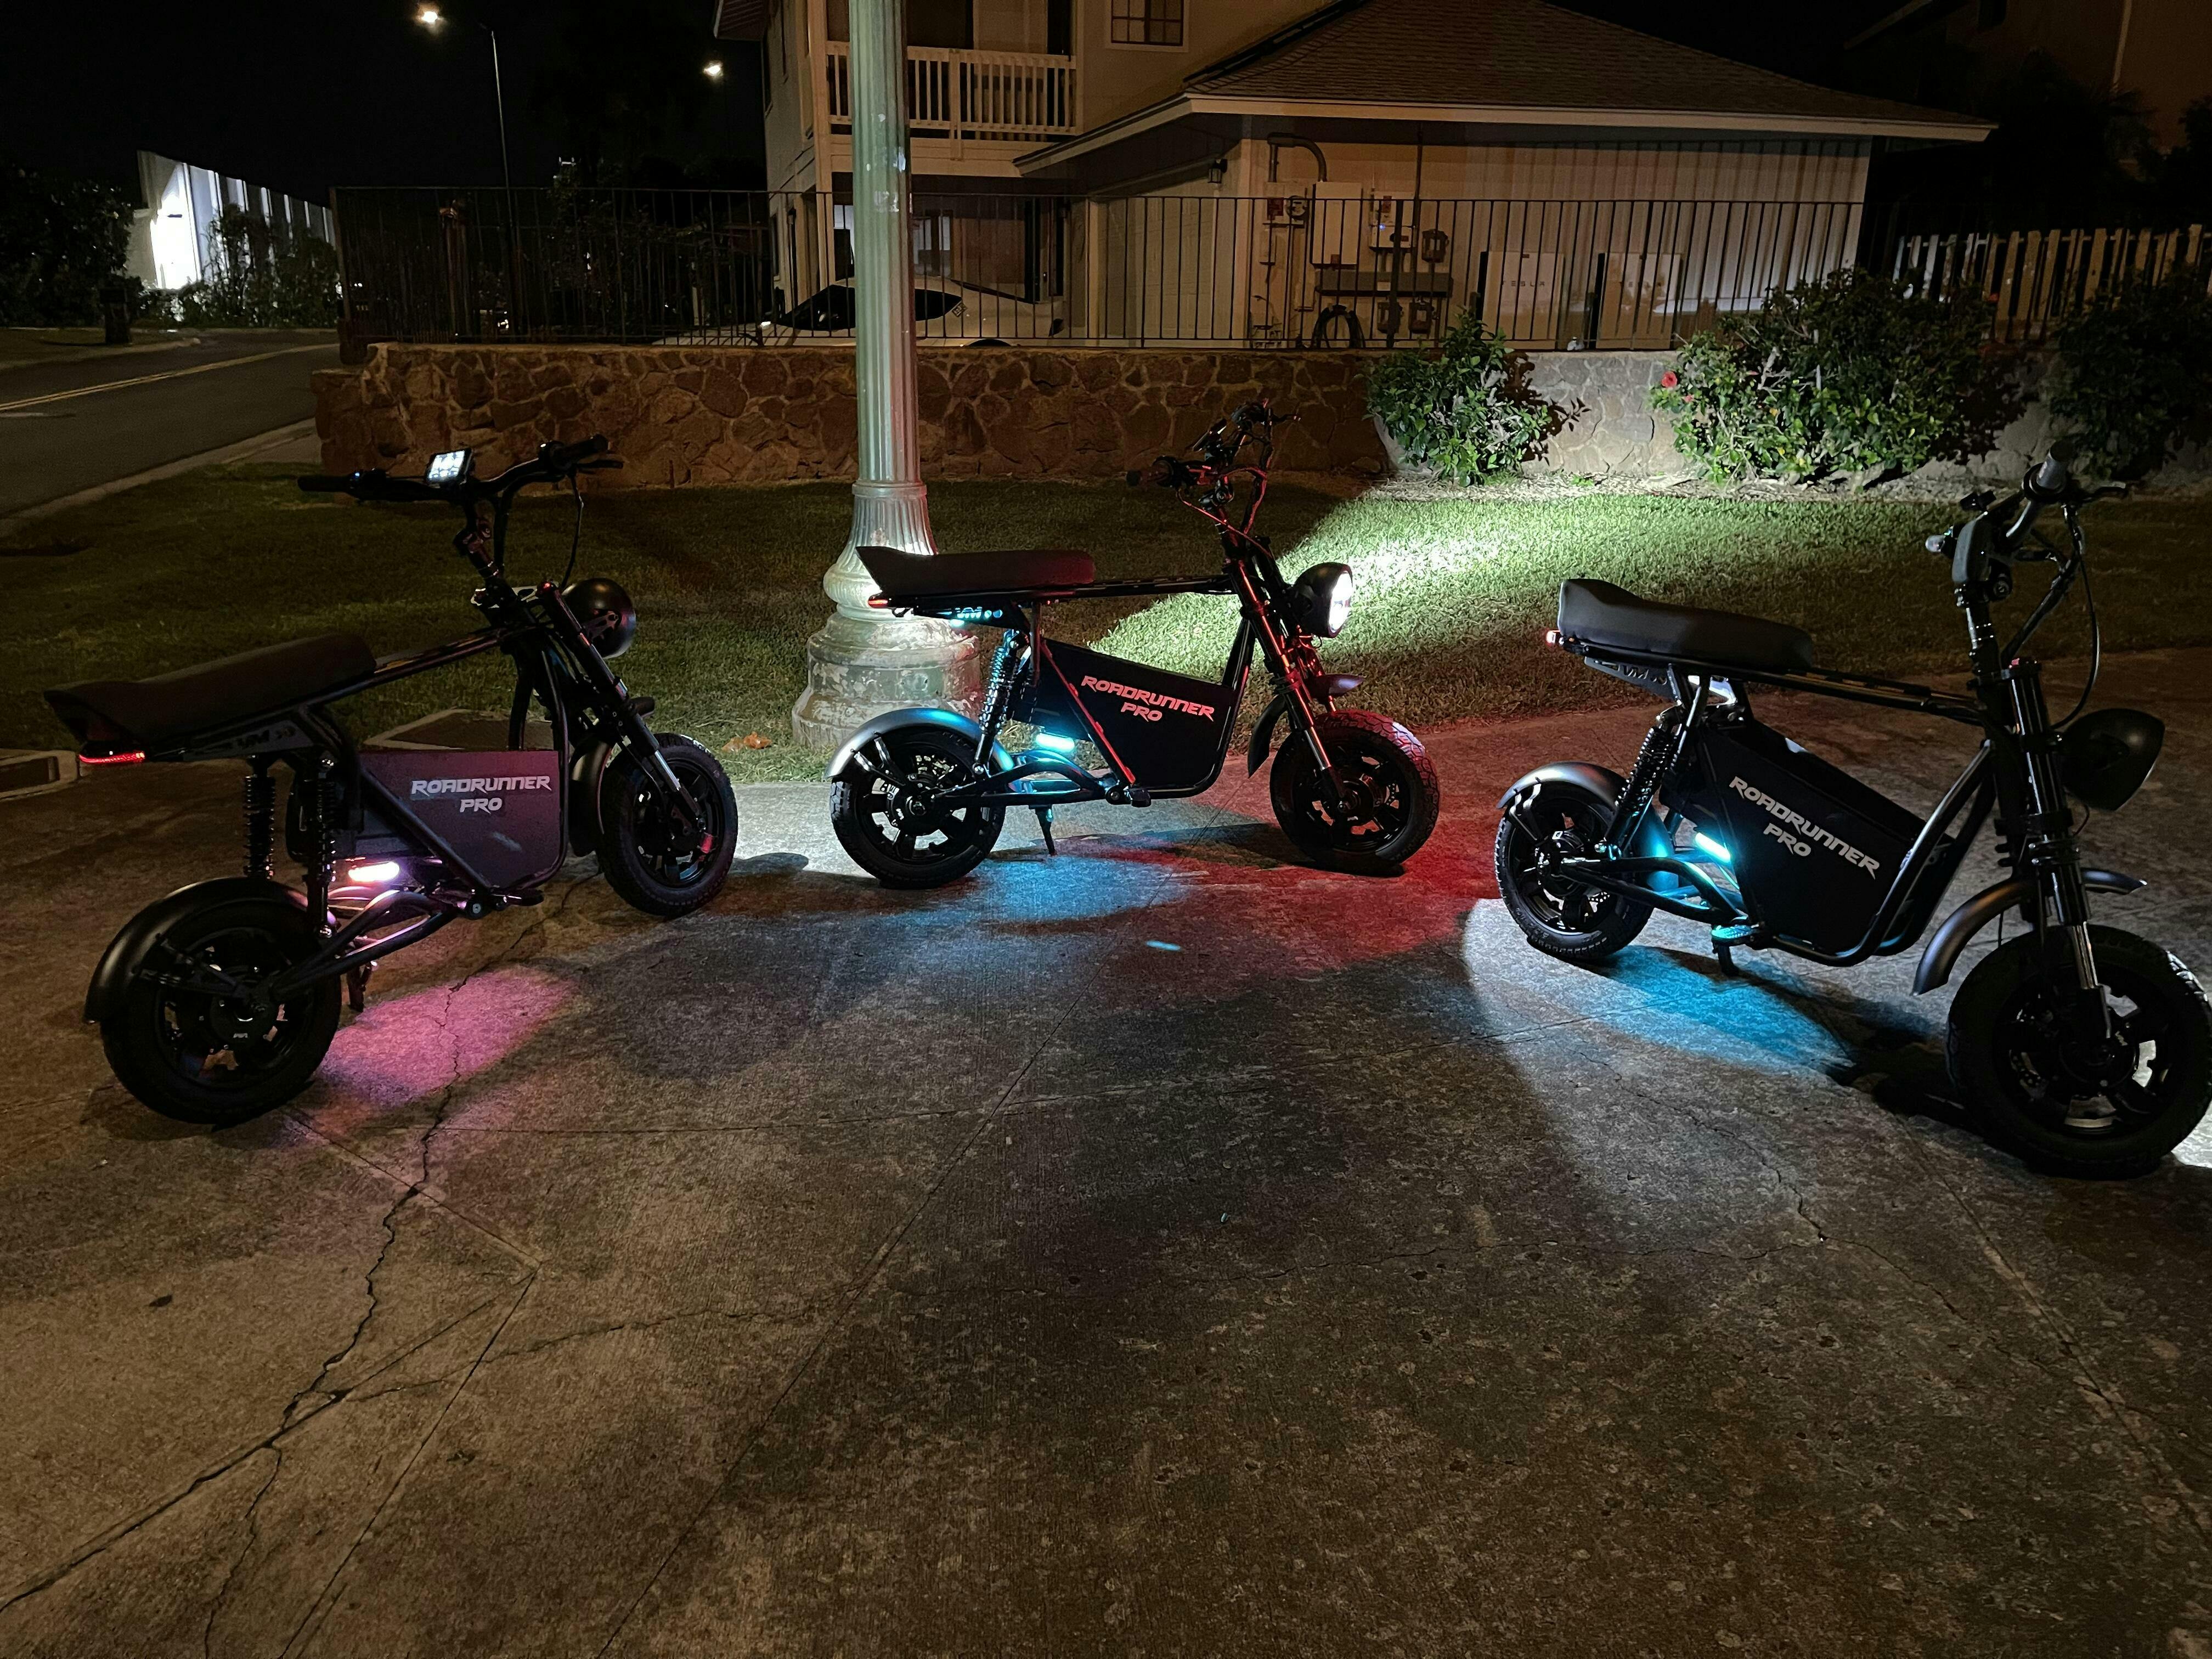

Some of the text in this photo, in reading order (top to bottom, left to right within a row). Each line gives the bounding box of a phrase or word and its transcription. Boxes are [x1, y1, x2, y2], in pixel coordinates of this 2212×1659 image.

[1081, 675, 1215, 722] ROADRUNNER
[1121, 702, 1163, 722] PRO
[411, 776, 552, 797] ROADRUNNER
[460, 798, 503, 814] PRO
[1729, 776, 1880, 880] ROADRUNNER
[1763, 823, 1812, 856] PRO
